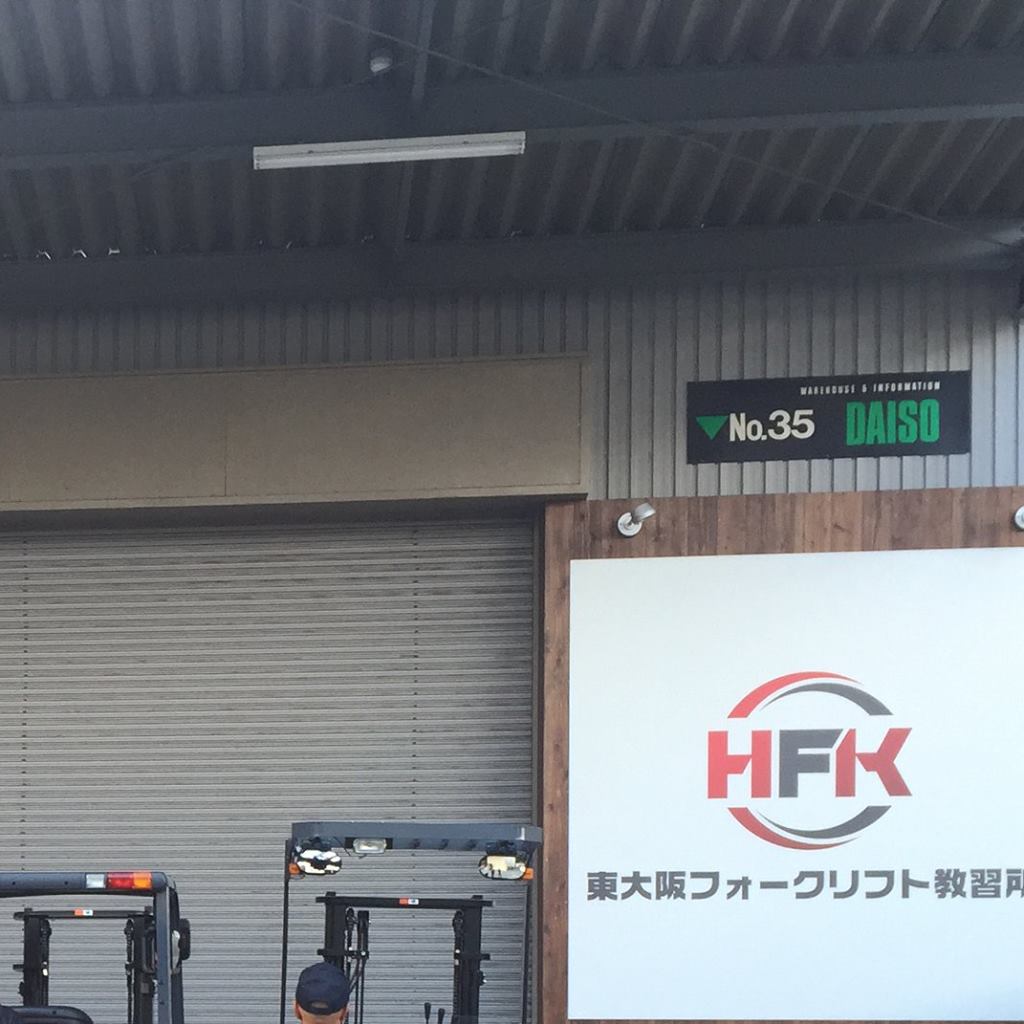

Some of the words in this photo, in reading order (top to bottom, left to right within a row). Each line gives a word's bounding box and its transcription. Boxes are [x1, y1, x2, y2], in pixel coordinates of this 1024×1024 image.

[873, 380, 941, 393] INFORMATION
[729, 409, 816, 442] No.35
[846, 399, 940, 446] DAISO
[707, 727, 913, 799] HFK
[587, 868, 1024, 901] 東大阪フォークリフト教習所
